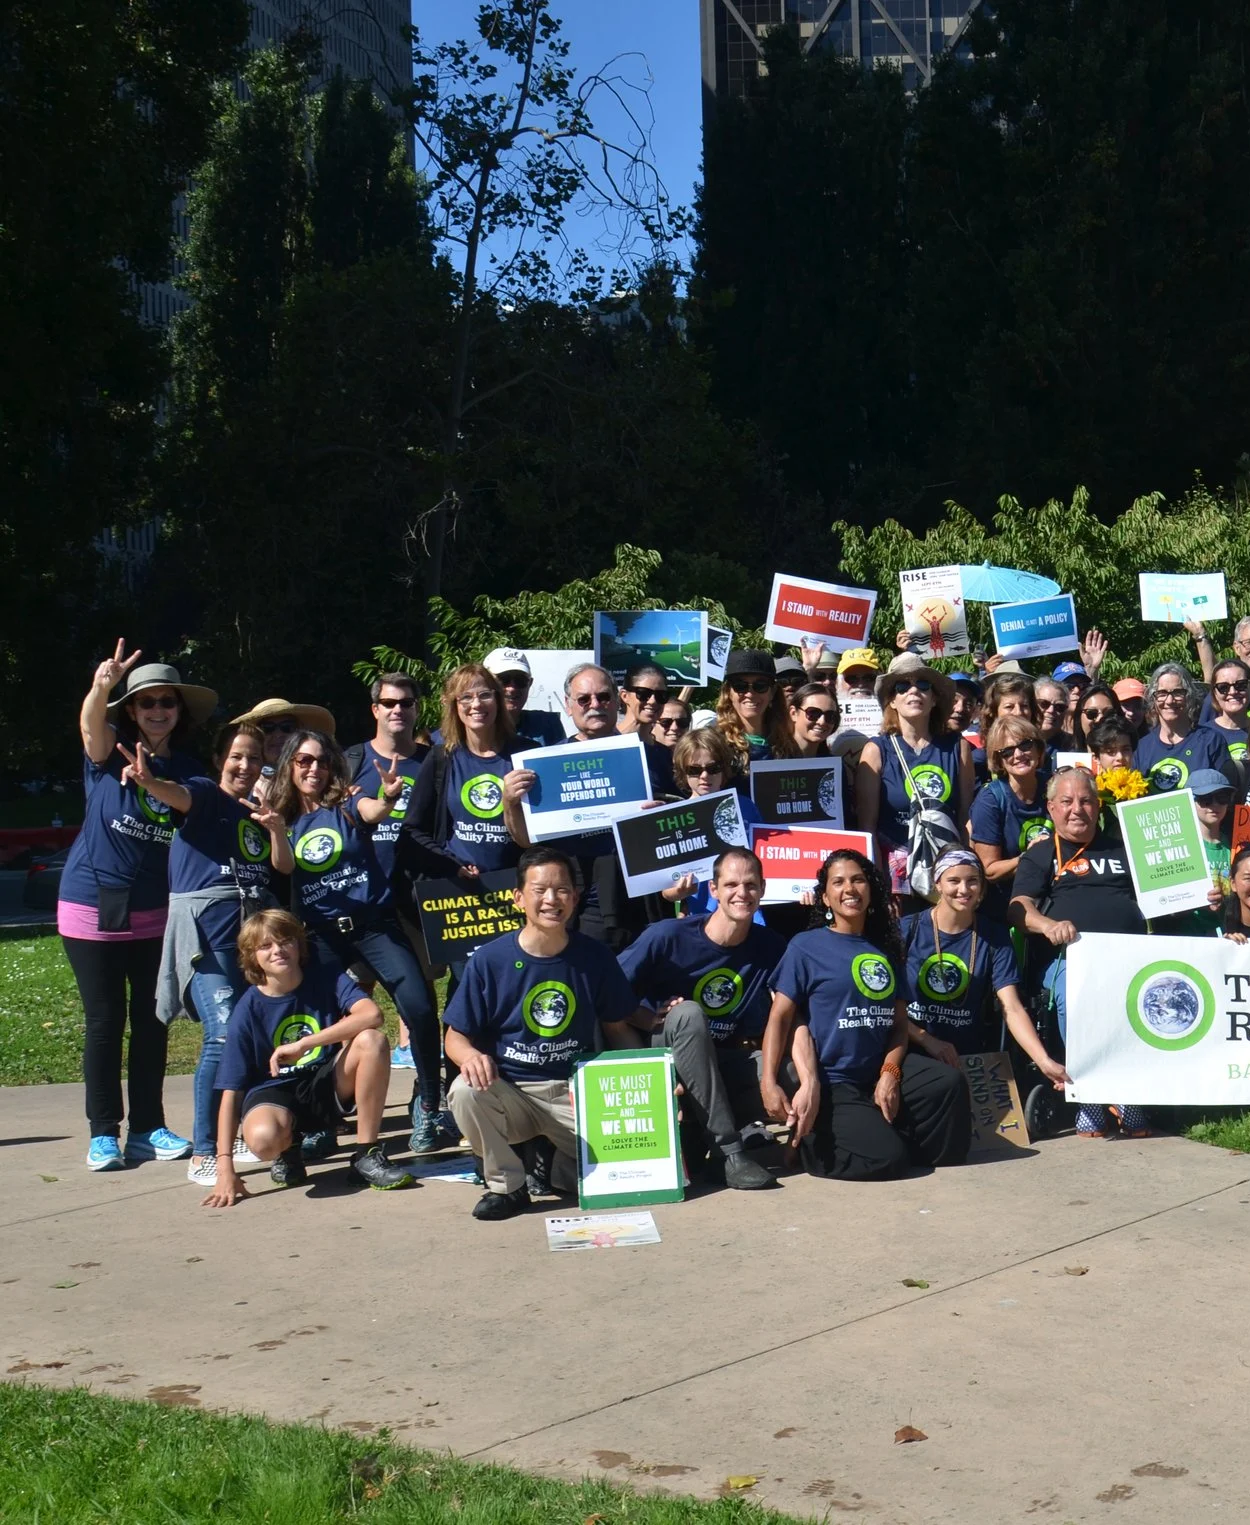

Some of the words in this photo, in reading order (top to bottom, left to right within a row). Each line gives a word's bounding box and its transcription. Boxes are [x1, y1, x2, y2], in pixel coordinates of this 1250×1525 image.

[903, 572, 927, 582] RISE
[782, 600, 786, 611] I
[787, 601, 814, 617] STAND
[829, 609, 862, 625] REALITY
[1000, 619, 1026, 632] DENIAL
[1038, 617, 1044, 626] A
[1044, 612, 1068, 625] POLICY
[563, 758, 604, 772] FIGHT
[561, 781, 582, 791] YOUR
[583, 777, 610, 788] WORLD
[780, 777, 807, 790] THIS
[560, 790, 594, 803] DEPENDS
[596, 788, 607, 798] ON
[608, 787, 616, 797] IT
[776, 802, 792, 814] OUR
[792, 800, 812, 813] HOME
[123, 814, 144, 830] The
[656, 812, 696, 832] THIS
[1136, 813, 1151, 827] WE
[1153, 806, 1182, 824] MUST
[111, 819, 151, 840] Reality
[457, 821, 473, 831] The
[1143, 827, 1159, 841] WE
[1160, 821, 1182, 837] CAN
[675, 830, 683, 839] IS
[655, 844, 678, 859] OUR
[678, 835, 709, 854] HOME
[1159, 838, 1171, 848] AND
[760, 846, 764, 859] I
[767, 847, 800, 860] STAND
[803, 851, 818, 859] WITH
[1145, 852, 1162, 866] WE
[1165, 845, 1191, 862] WILL
[1150, 870, 1174, 880] CLIMATE
[1176, 866, 1195, 875] CRISIS
[1156, 864, 1174, 872] SOLVE
[302, 881, 320, 895] The
[320, 865, 358, 886] Climate
[423, 895, 480, 911] CLIMATE
[484, 890, 514, 903] CHA
[446, 912, 459, 925] IS
[463, 911, 474, 922] A
[442, 923, 495, 940] JUSTICE
[846, 1006, 868, 1017] The
[928, 1004, 970, 1017] Climate
[838, 1017, 876, 1029] Reality
[513, 1041, 537, 1053] The
[539, 1038, 578, 1053] Climate
[504, 1046, 547, 1066] Reality
[599, 1077, 616, 1091] WE
[619, 1074, 653, 1089] MUST
[604, 1092, 622, 1107] WE
[625, 1090, 649, 1106] CAN
[965, 1056, 989, 1105] STAND
[980, 1108, 997, 1127] ON
[620, 1107, 635, 1117] AND
[601, 1120, 621, 1136] WE
[624, 1117, 655, 1134] WILL
[603, 1143, 632, 1151] CLIMATE
[634, 1141, 657, 1149] CRISIS
[611, 1137, 633, 1145] SOLVE
